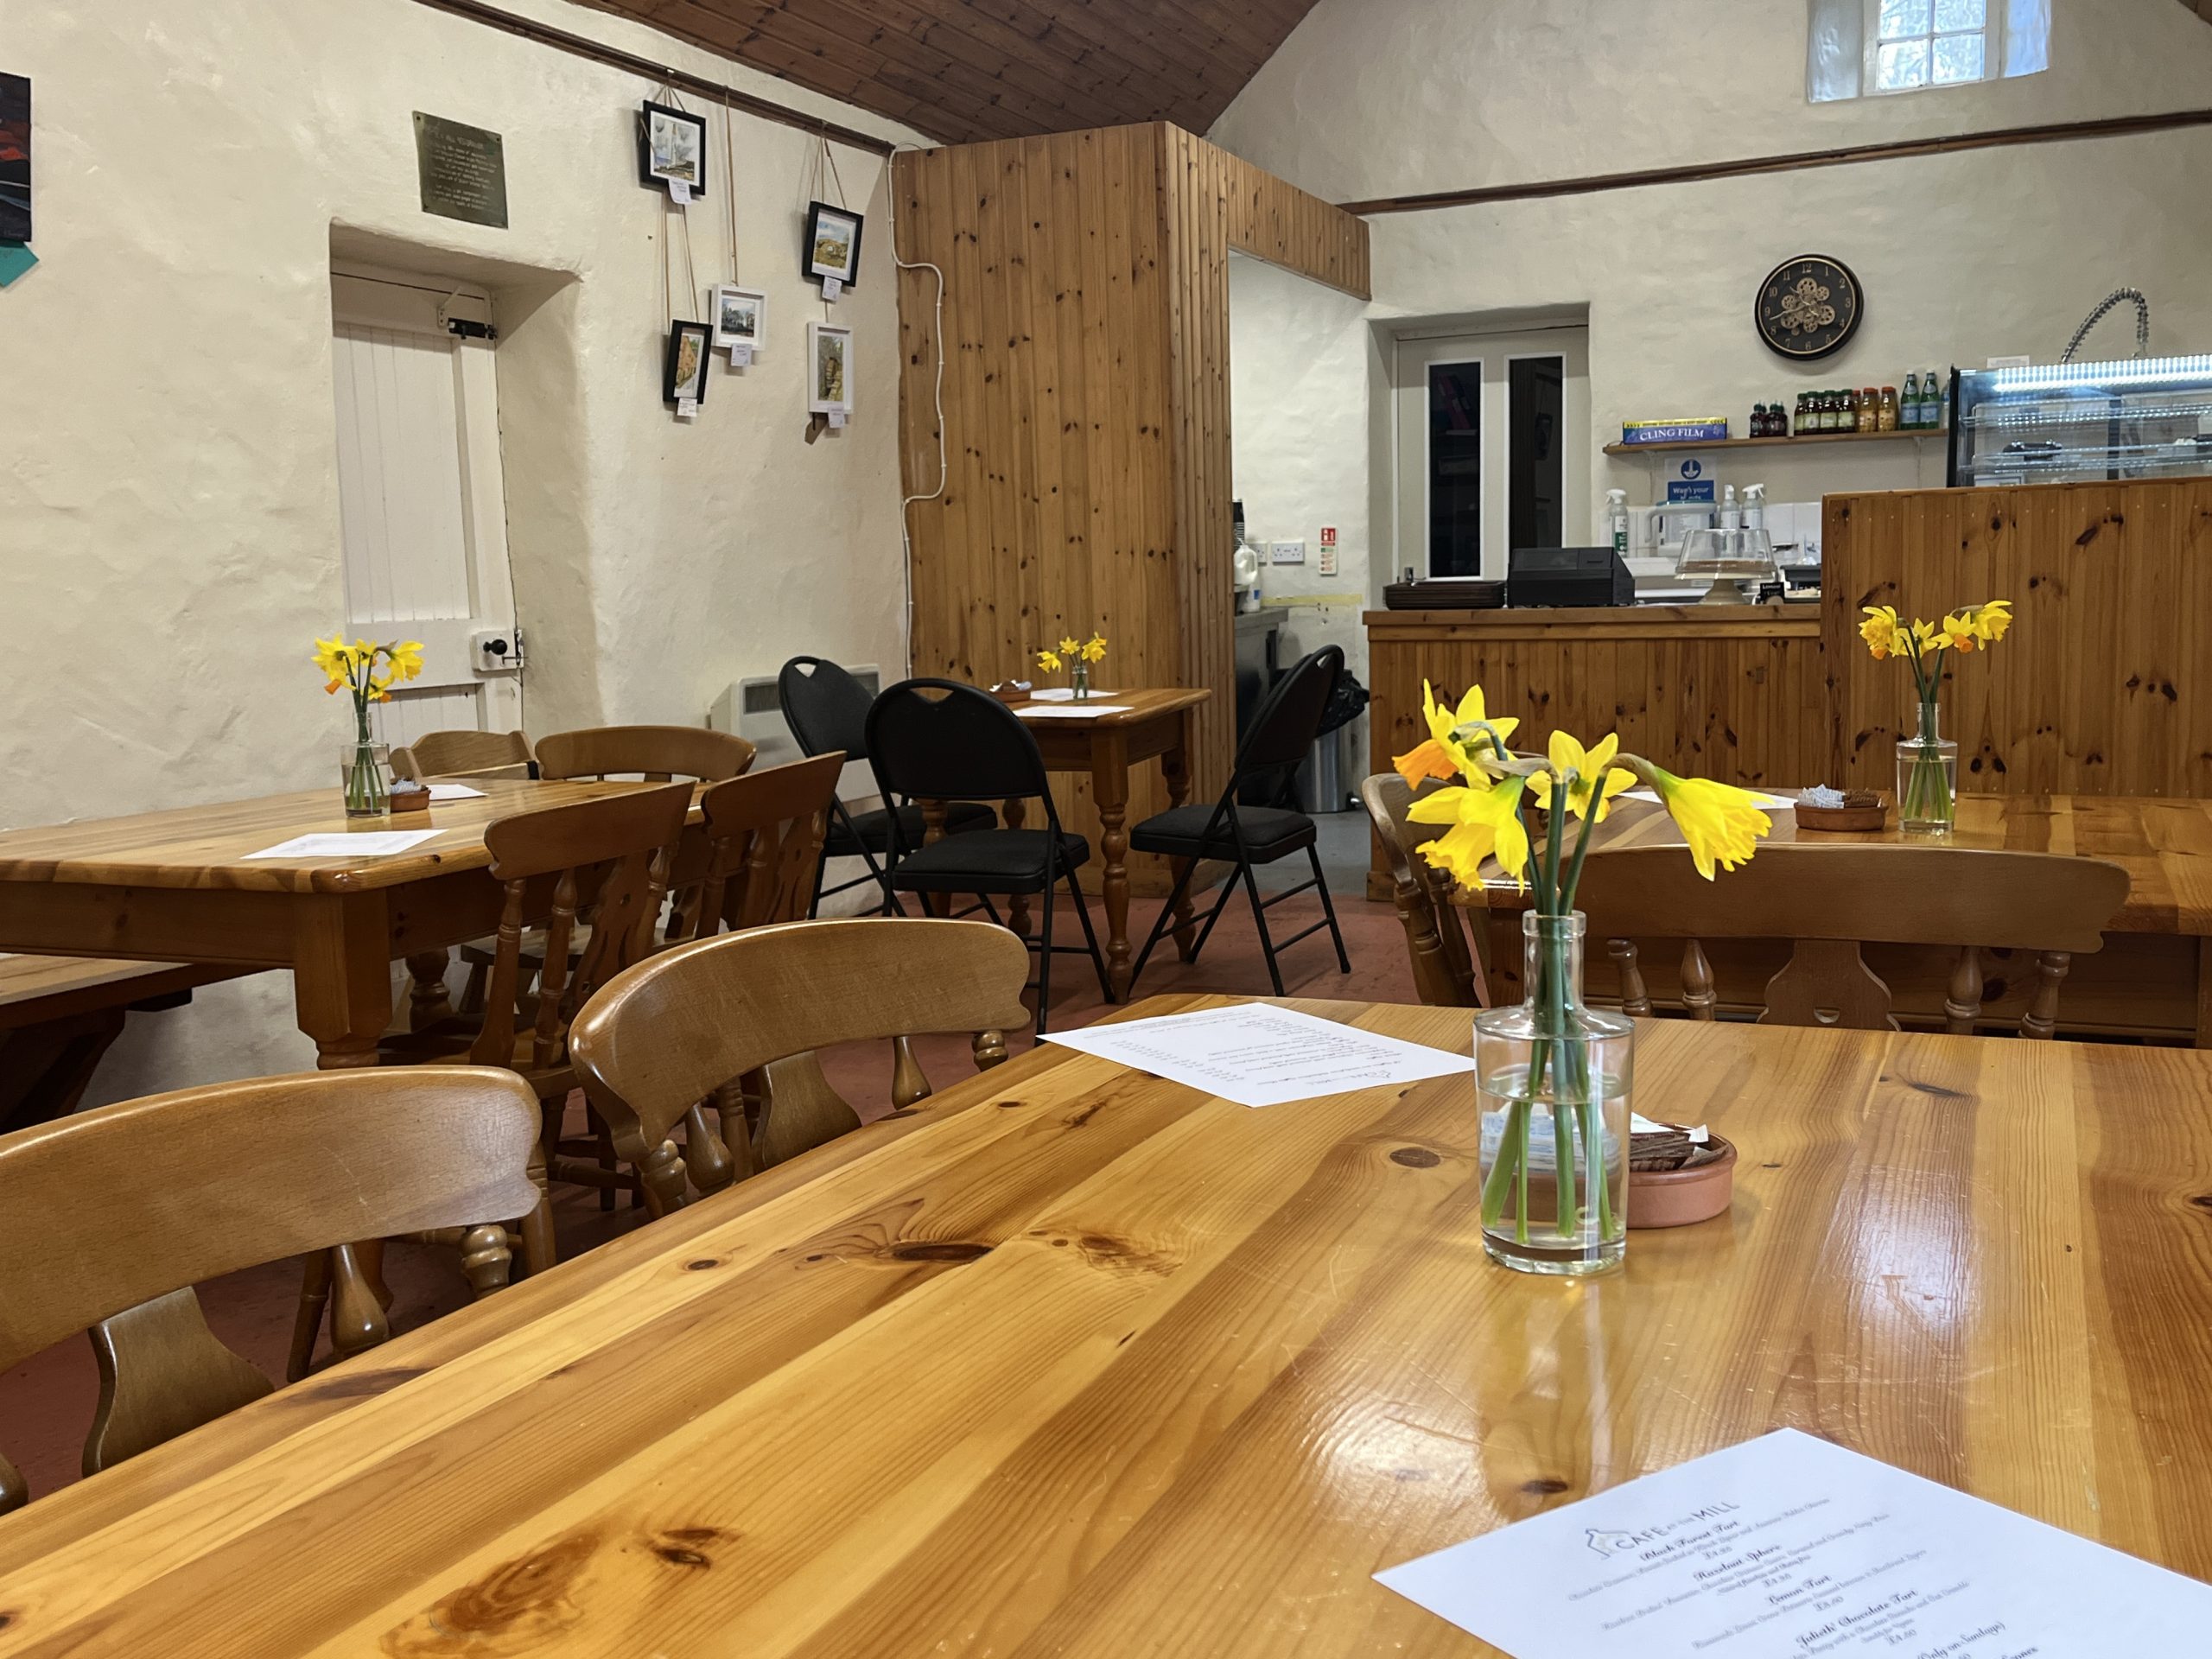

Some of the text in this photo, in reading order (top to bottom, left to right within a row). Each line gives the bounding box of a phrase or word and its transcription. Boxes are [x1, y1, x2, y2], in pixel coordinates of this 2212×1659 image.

[1783, 271, 1790, 281] 11
[1802, 264, 1812, 273] 12
[1769, 287, 1778, 296] 10
[1839, 278, 1846, 289] 2
[1640, 428, 1705, 442] CLING FILM
[1616, 1527, 1669, 1549] CAFE
[1691, 1502, 1740, 1521] MILL
[1640, 1543, 1675, 1562] Black
[1674, 1531, 1711, 1548] Forest
[1713, 1521, 1739, 1535] Tart
[1694, 1559, 1744, 1580] Hazelnut
[1746, 1544, 1782, 1562] Sphere
[1765, 1586, 1804, 1605] Lemon
[1802, 1574, 1832, 1590] Tart
[1838, 1601, 1891, 1627] Chocolate
[1889, 1589, 1918, 1605] Tart
[1960, 1621, 2005, 1645] Sundays)
